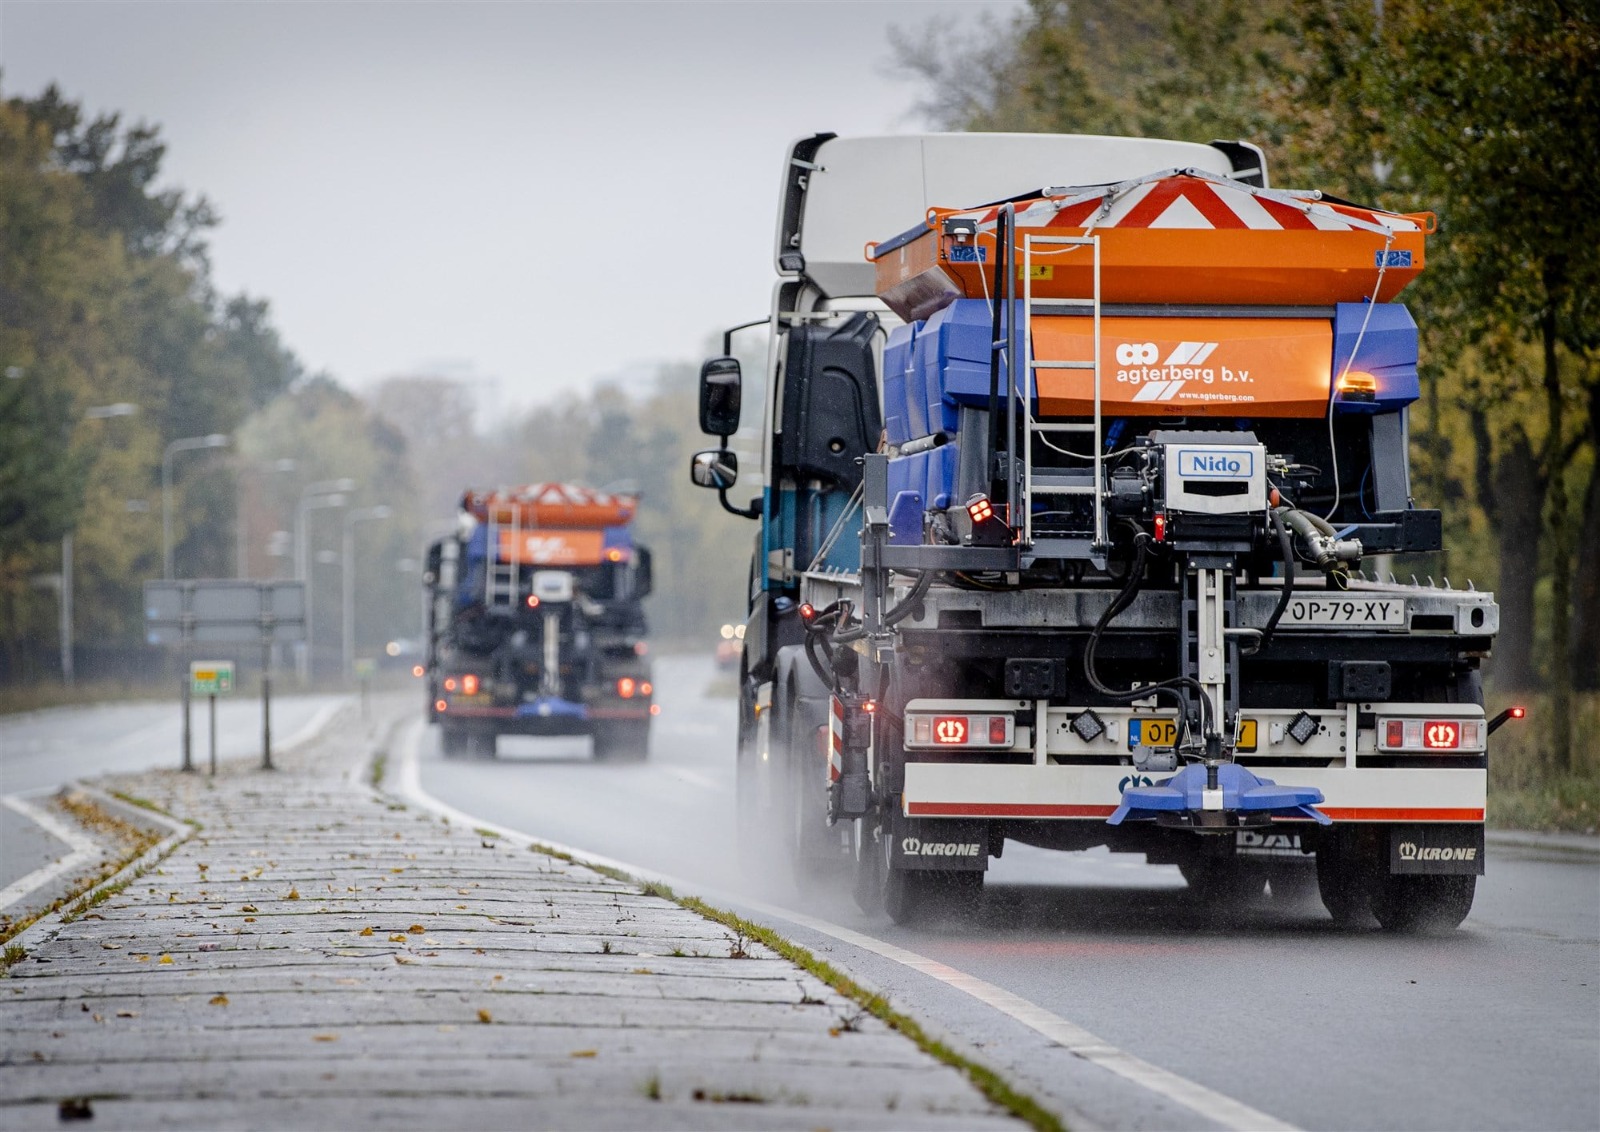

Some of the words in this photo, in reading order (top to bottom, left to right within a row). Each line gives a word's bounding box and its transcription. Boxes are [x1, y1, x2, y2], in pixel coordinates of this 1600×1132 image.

[1116, 365, 1214, 384] agterberg
[1221, 366, 1254, 383] b.v.
[1178, 391, 1255, 402] www.agterberg.com
[1193, 456, 1241, 471] Nido
[1292, 602, 1390, 621] OP-79-XY
[921, 843, 980, 856] KRONE
[1417, 847, 1476, 861] KRONE
